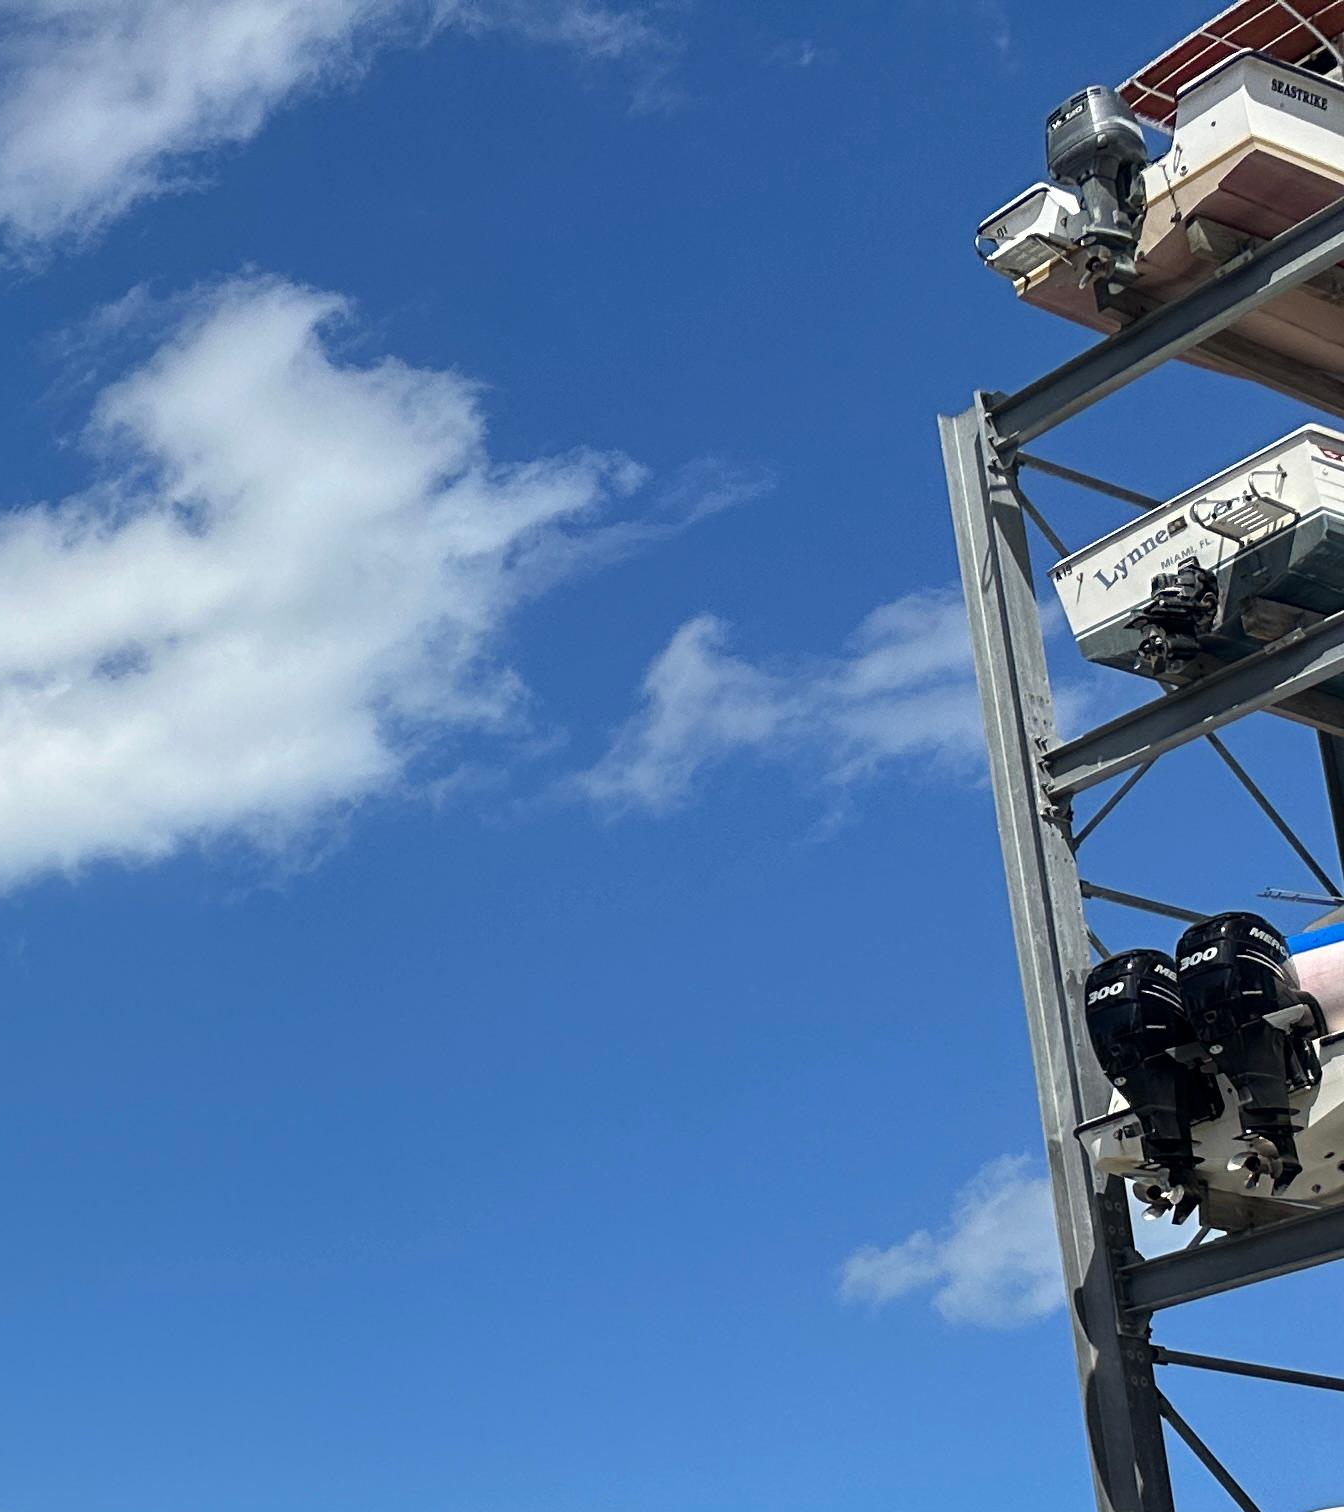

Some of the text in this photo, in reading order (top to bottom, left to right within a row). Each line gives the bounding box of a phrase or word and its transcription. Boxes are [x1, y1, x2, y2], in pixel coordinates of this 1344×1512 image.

[1271, 78, 1328, 111] SEASTRIKE
[1092, 528, 1170, 591] Lynne
[1179, 946, 1218, 973] 300
[1087, 981, 1125, 1006] 300
